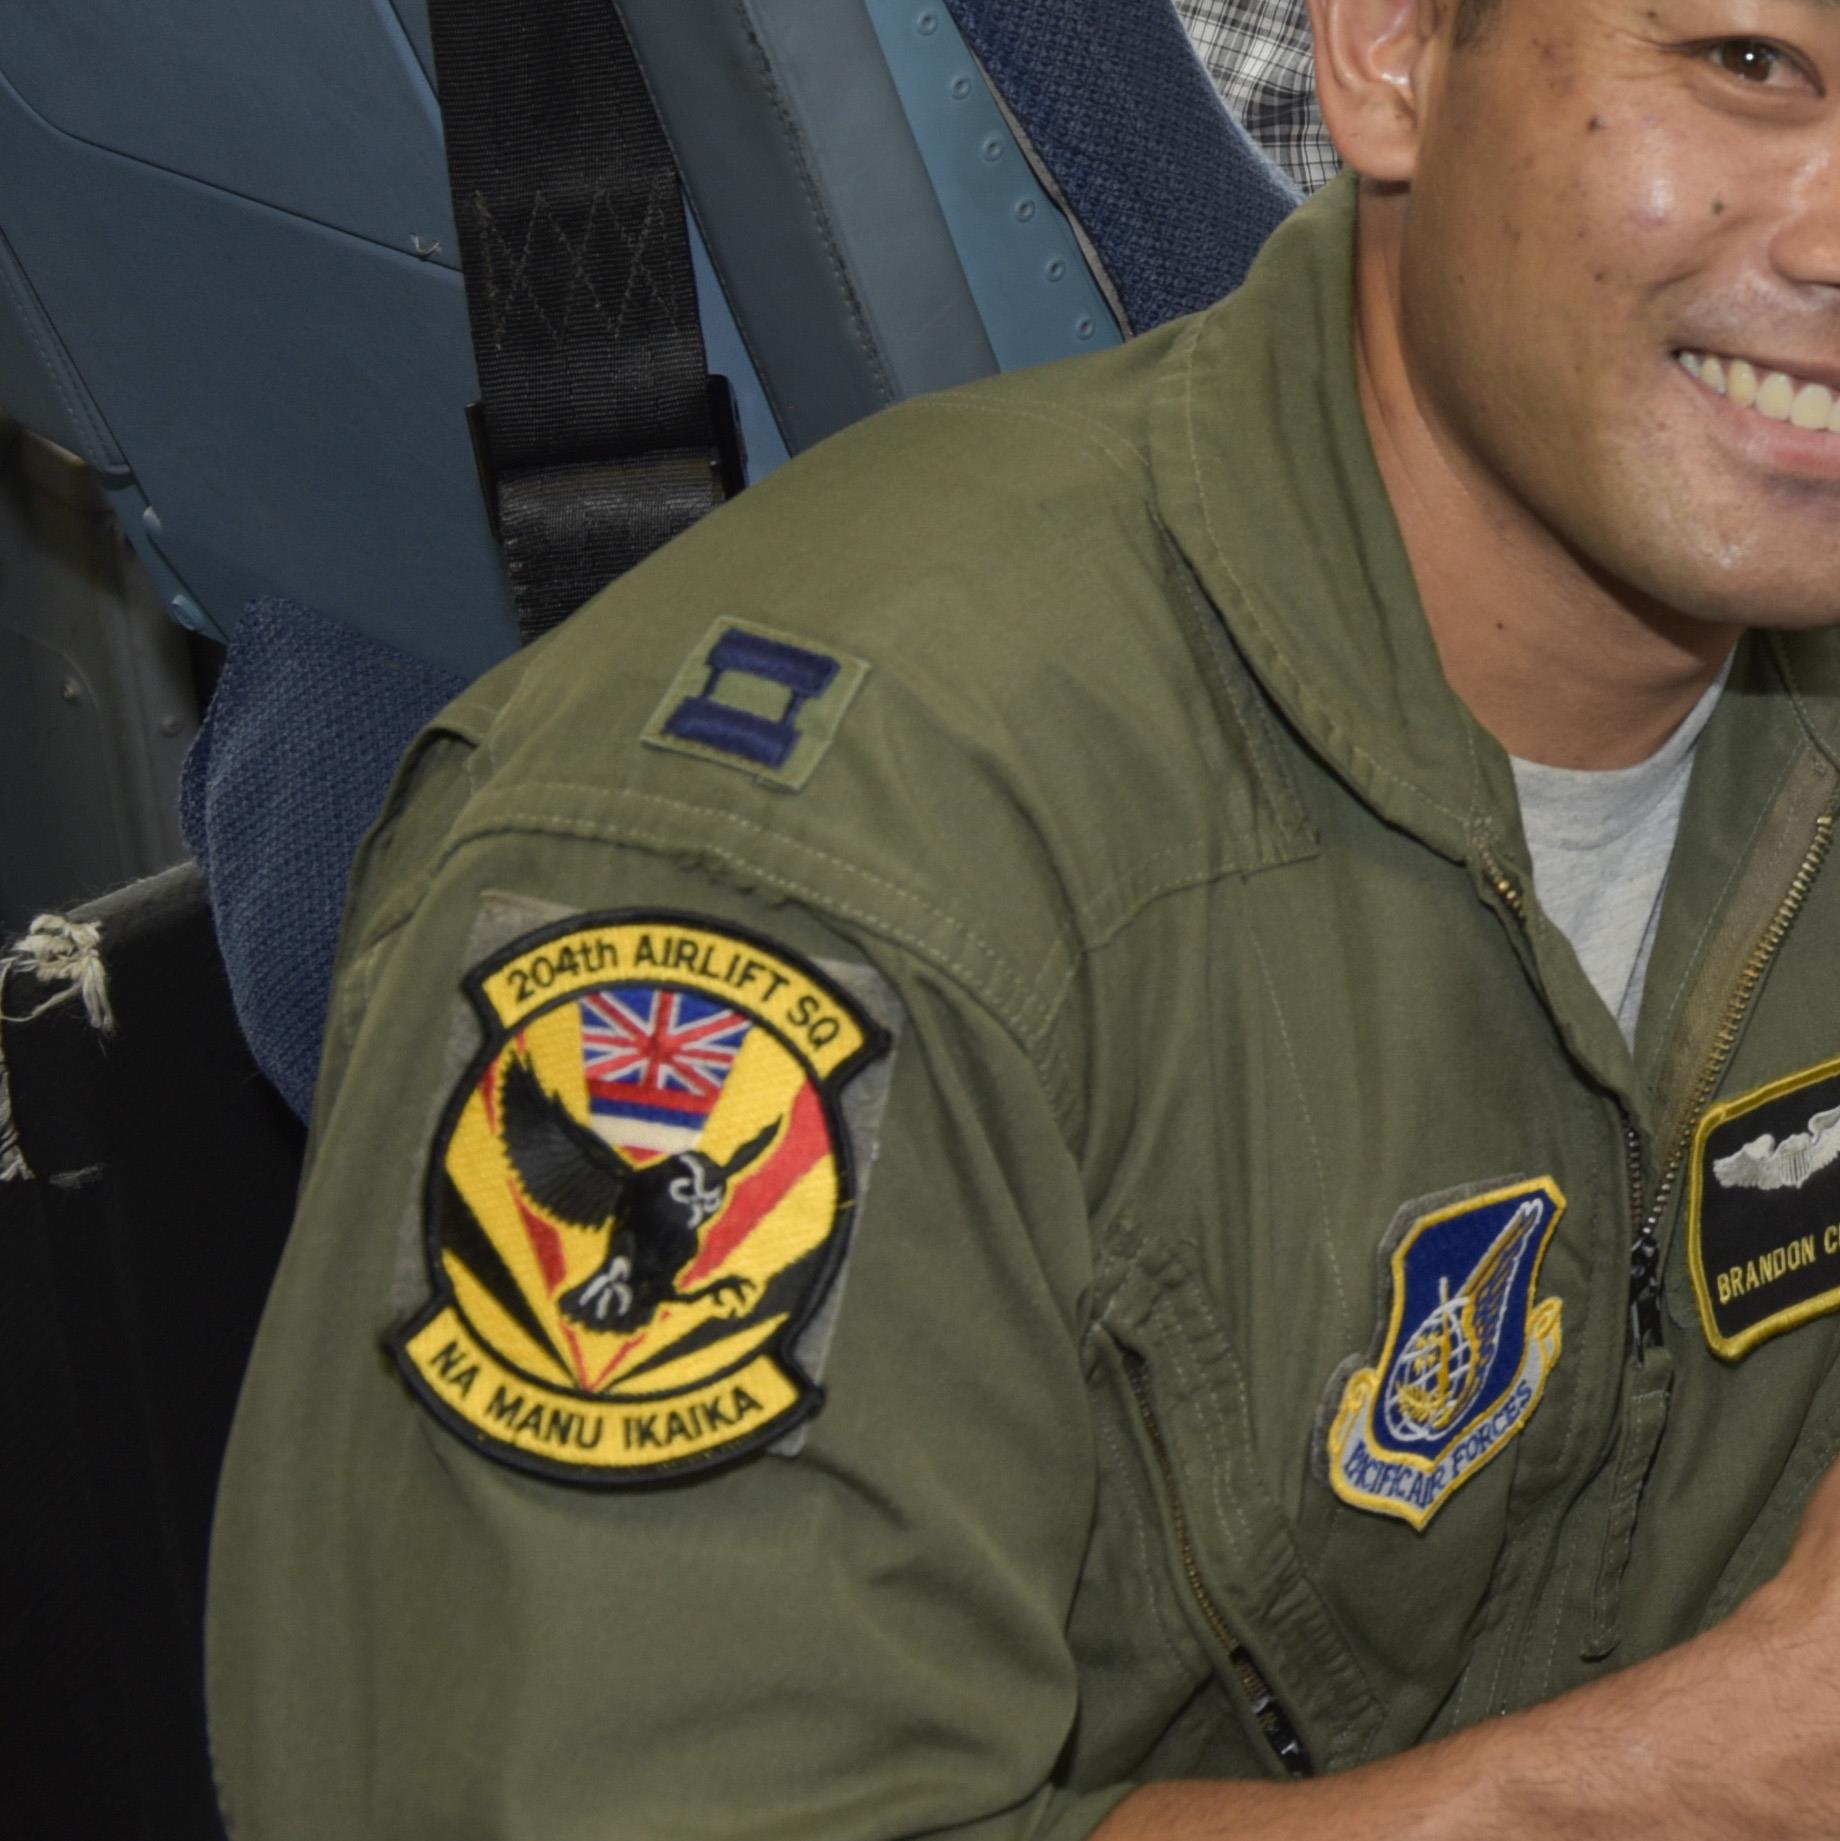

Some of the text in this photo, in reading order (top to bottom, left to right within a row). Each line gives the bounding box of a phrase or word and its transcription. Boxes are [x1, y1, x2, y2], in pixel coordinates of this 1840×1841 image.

[506, 933, 842, 1052] 204th AIRLIFT SQ
[1716, 1234, 1817, 1306] BRANDON
[428, 1339, 764, 1452] NA MANU IKAIKA
[1343, 1380, 1533, 1509] PACIFIC AIR FORCES
